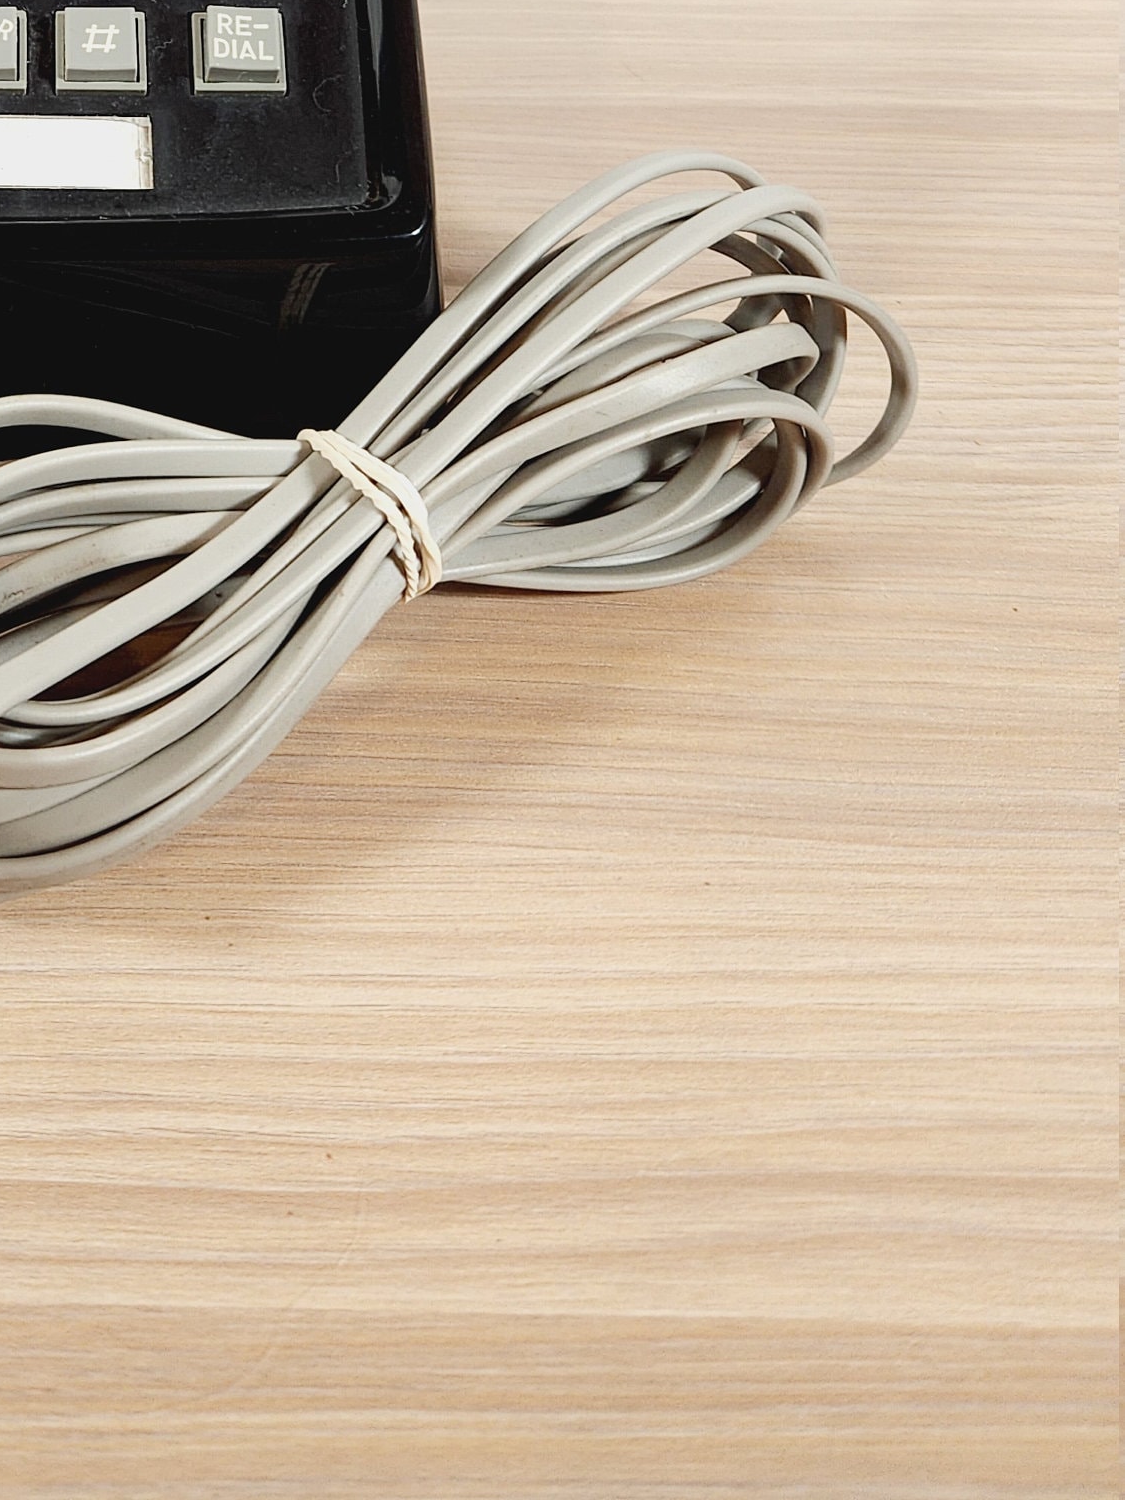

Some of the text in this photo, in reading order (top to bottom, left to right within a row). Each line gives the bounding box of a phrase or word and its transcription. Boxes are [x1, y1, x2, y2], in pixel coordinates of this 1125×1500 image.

[217, 12, 269, 36] RE-
[81, 23, 120, 53] #
[213, 37, 274, 61] DIAL
